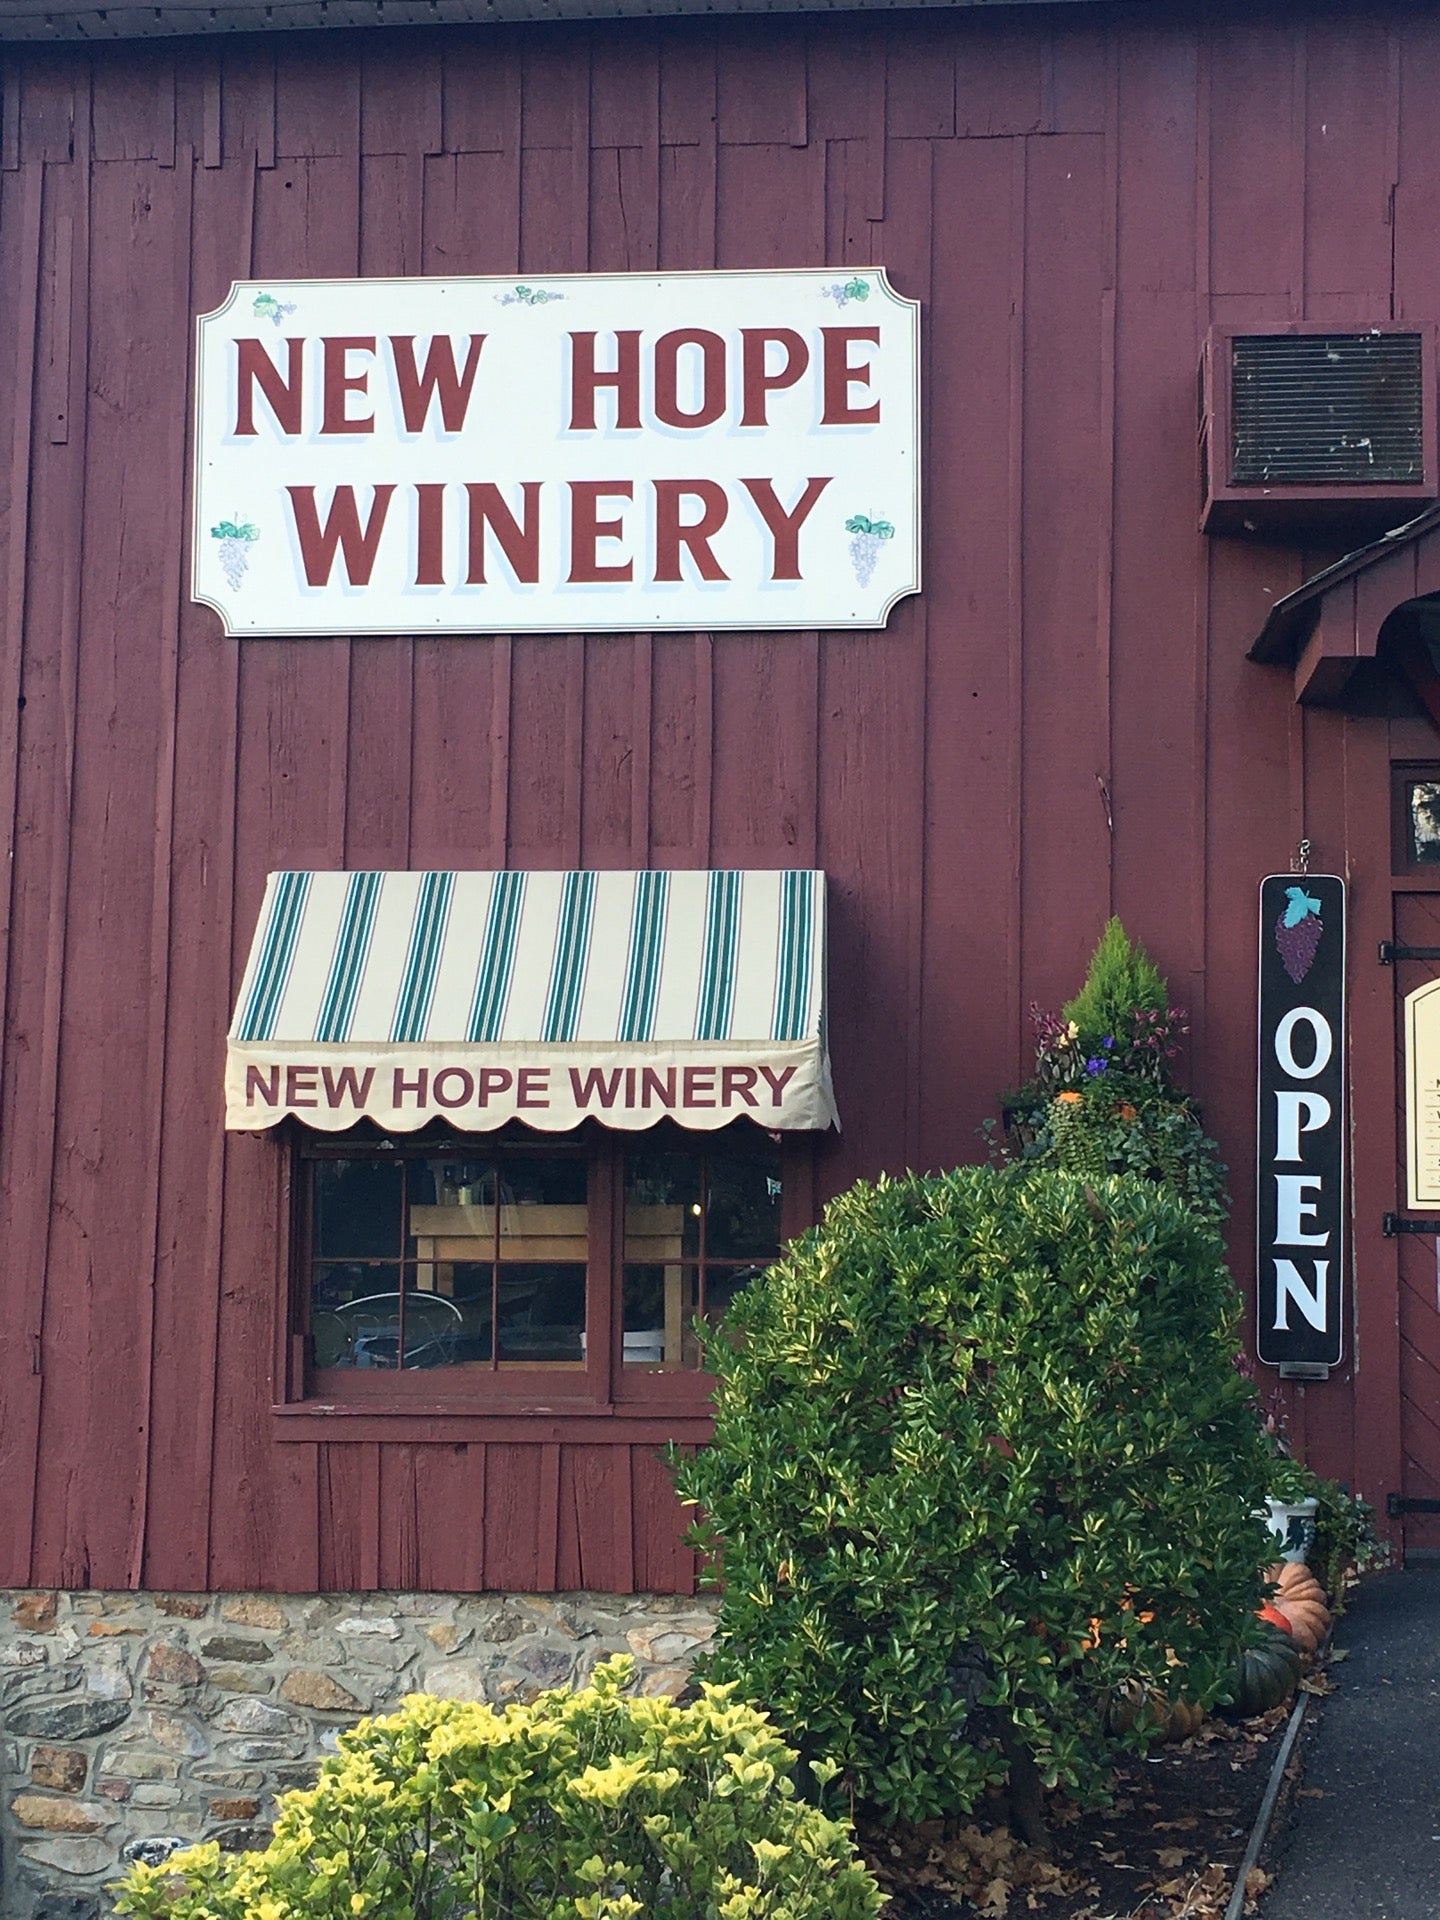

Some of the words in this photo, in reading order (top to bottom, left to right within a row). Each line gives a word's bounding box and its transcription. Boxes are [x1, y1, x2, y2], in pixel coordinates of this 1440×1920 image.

[232, 333, 488, 436] NEW
[567, 325, 881, 430] HOPE
[285, 476, 835, 587] WINERY
[245, 1064, 376, 1109] NEW
[392, 1066, 551, 1109] HOPE
[568, 1065, 799, 1110] WINERY
[1272, 1006, 1333, 1333] OPEN
